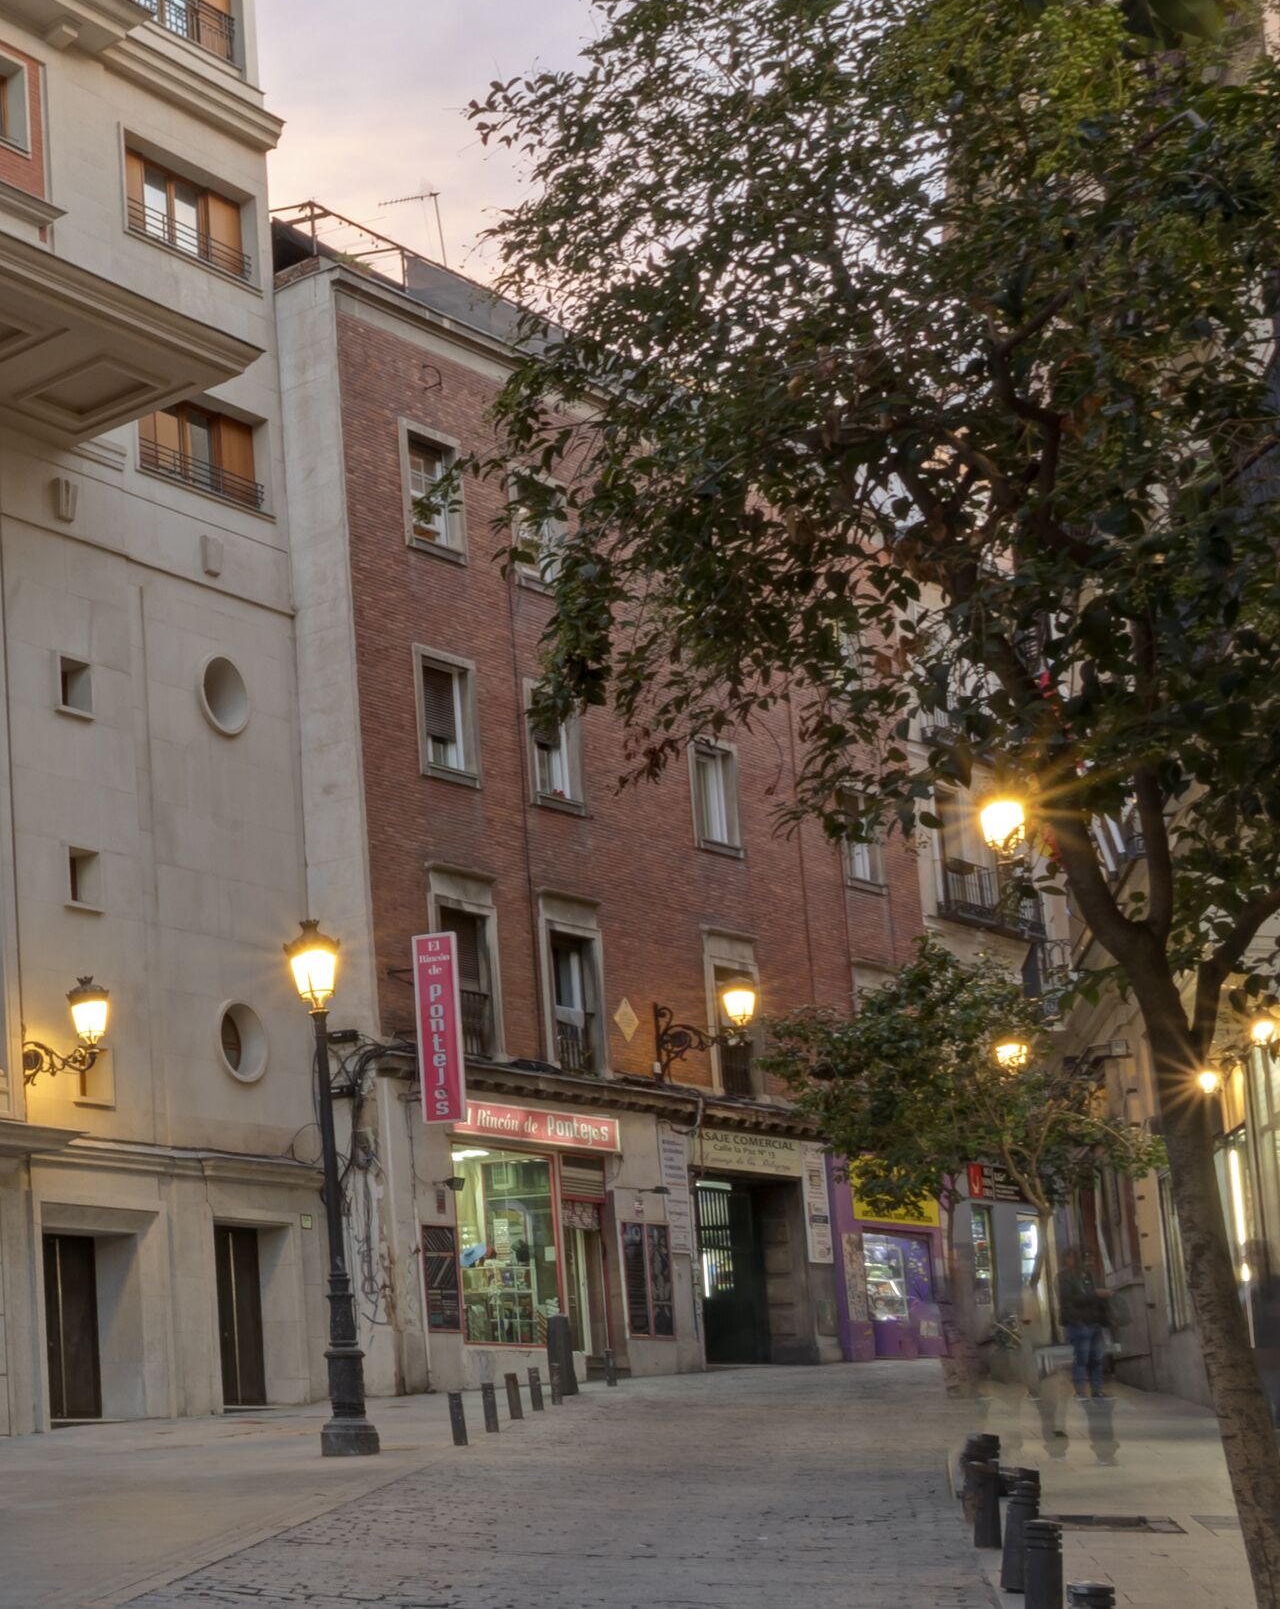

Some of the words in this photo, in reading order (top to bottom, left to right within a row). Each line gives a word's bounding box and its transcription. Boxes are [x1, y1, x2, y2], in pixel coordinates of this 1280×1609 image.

[427, 941, 440, 951] El
[428, 965, 442, 975] de
[477, 1109, 519, 1131] Rincón
[524, 1116, 539, 1134] de
[547, 1115, 609, 1145] Pontejos
[691, 1131, 730, 1143] PASAJE
[733, 1134, 795, 1151] COMERCIAL
